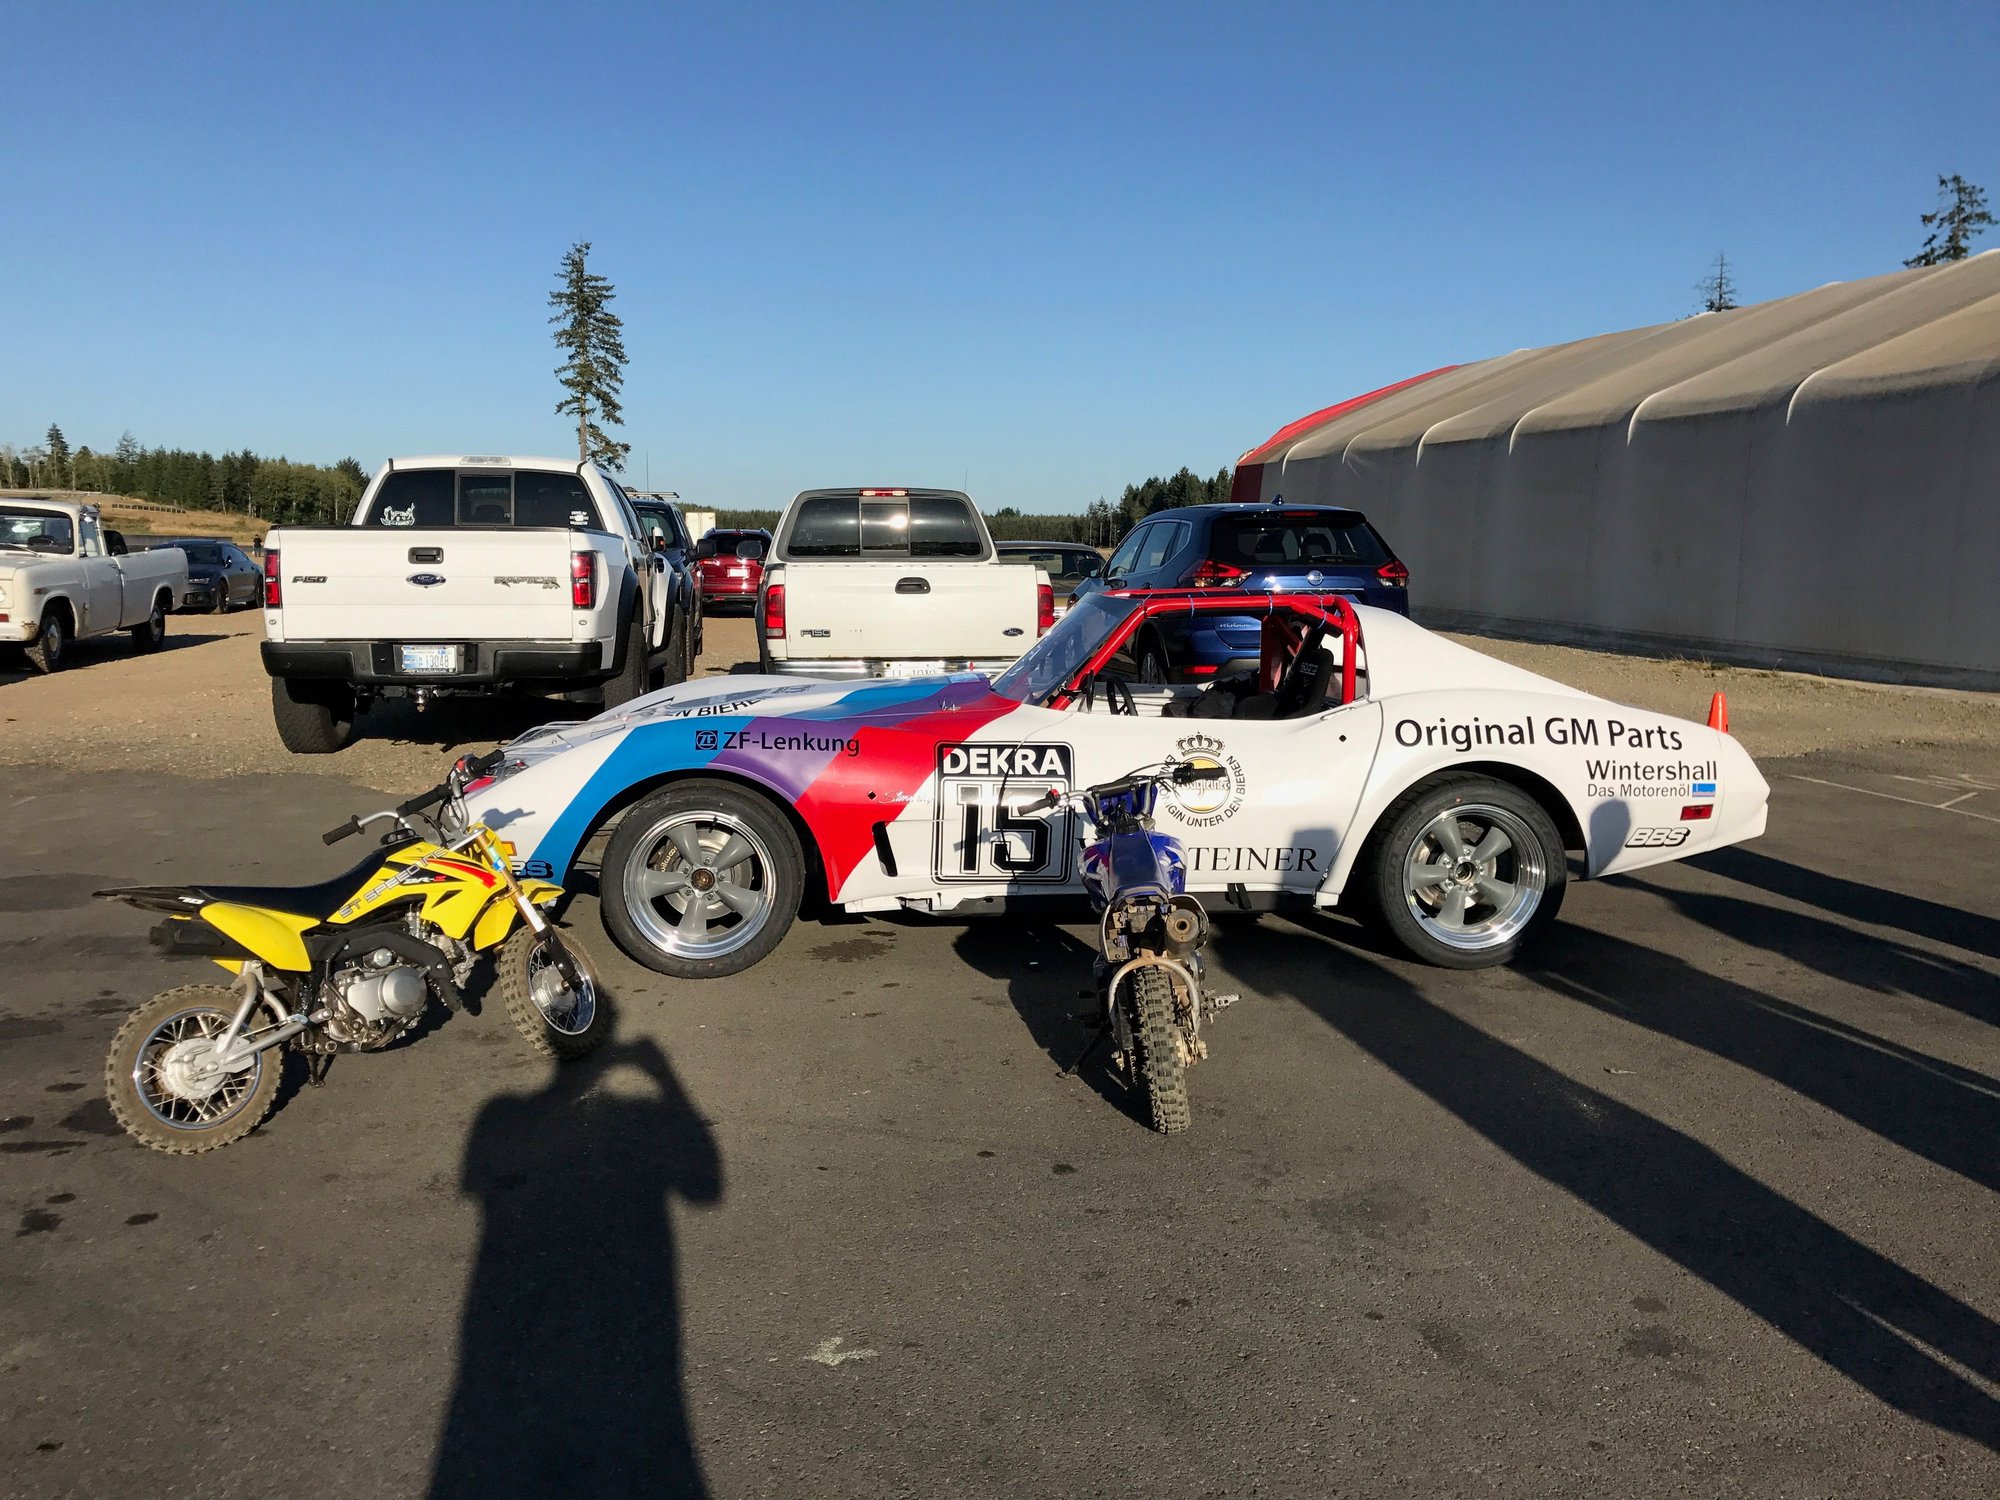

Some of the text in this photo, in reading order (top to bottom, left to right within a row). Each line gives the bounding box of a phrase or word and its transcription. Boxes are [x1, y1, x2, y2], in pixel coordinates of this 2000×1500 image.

[723, 731, 860, 757] ZF-Lenkung
[1395, 716, 1684, 752] Original GM Parts
[943, 747, 1066, 776] DEKRA
[1586, 759, 1718, 780] Wintershall
[1226, 755, 1246, 795] BIEREN
[1587, 783, 1691, 798] Das Motorenöl
[1224, 796, 1243, 818] DEN
[956, 783, 1052, 874] 15
[1186, 814, 1224, 828] UNTER
[1624, 827, 1691, 848] BBS
[511, 860, 554, 879] BS
[338, 898, 361, 918] ST
[363, 863, 420, 903] SPEED
